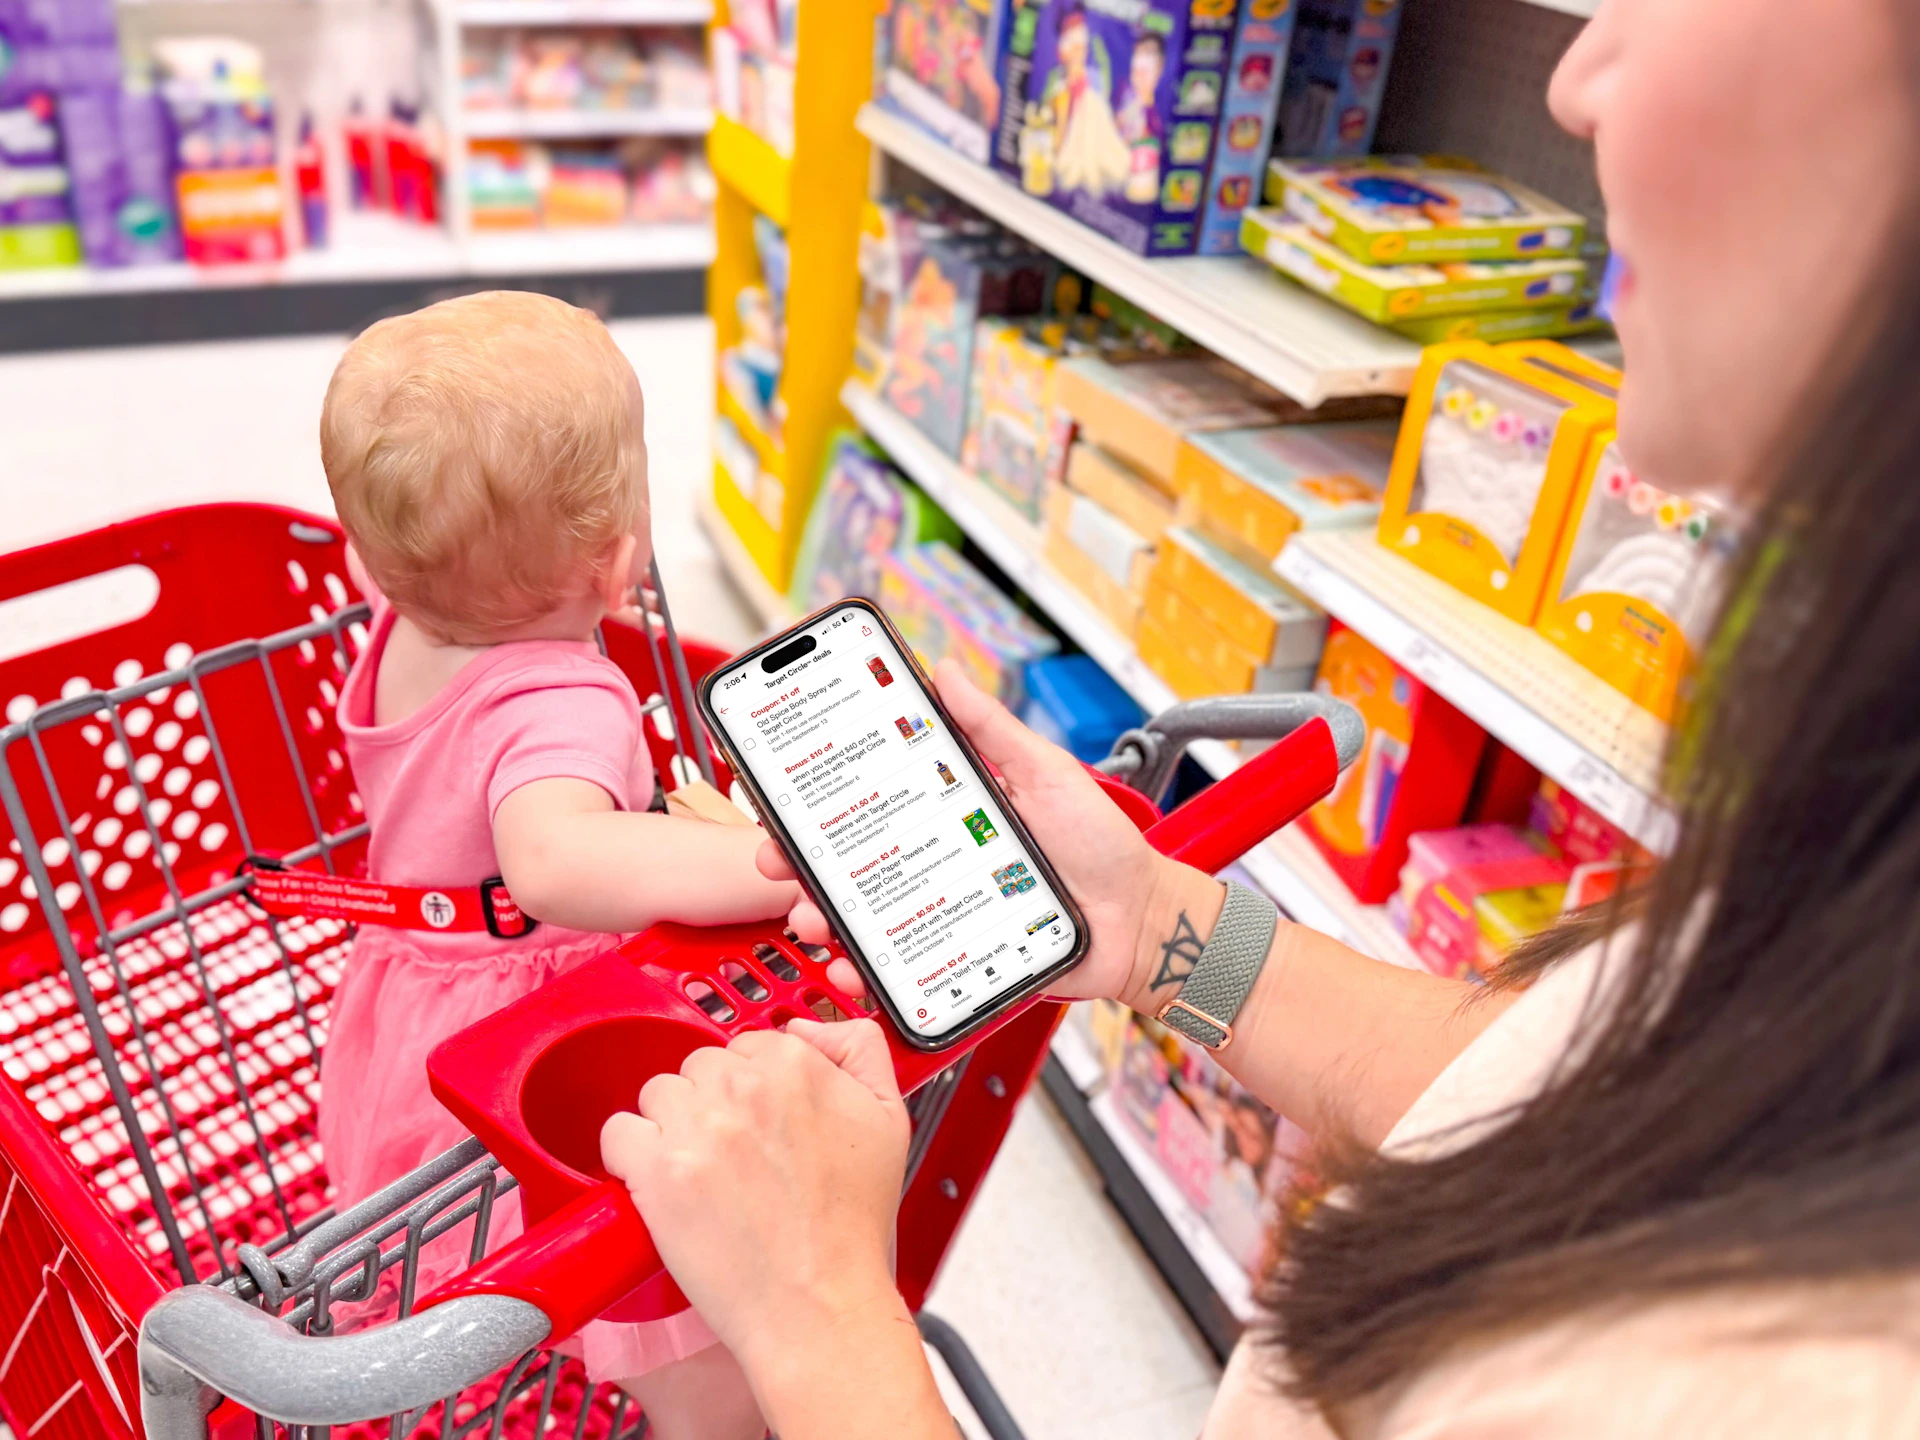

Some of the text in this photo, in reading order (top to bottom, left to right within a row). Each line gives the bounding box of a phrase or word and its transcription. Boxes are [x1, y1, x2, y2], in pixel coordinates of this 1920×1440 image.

[724, 677, 741, 690] 2:06
[832, 621, 842, 629] 5G
[764, 674, 788, 689] Target
[813, 650, 832, 663] deals
[751, 687, 800, 719] Coupon: $1 off
[757, 678, 842, 728] Old Spice Body Spray with
[767, 690, 862, 745] Limit 1-time use manufacturer coupon
[761, 711, 803, 736] Target Circle
[772, 740, 792, 753] Expires
[792, 723, 820, 742] September
[912, 736, 923, 744] days
[785, 742, 834, 774] Bonus: $10 off
[792, 730, 880, 784] when you spend $40 on Pet
[797, 738, 886, 793] care items with Target Circle
[802, 775, 843, 801] Limit 1-time use
[807, 796, 827, 809] Expires
[827, 779, 855, 798] September
[945, 787, 956, 795] days
[820, 792, 880, 830] Coupon: $1.50 off
[826, 789, 910, 840] Vaseline with Target Circle
[832, 792, 927, 850] Limit 1-time use manufacturer coupon
[837, 844, 857, 858] Expires
[857, 826, 885, 846] September
[850, 845, 900, 879] Coupon: $3 off
[856, 838, 940, 890] Bounty Paper Towels with
[867, 848, 962, 907] Limit 1-time use manufacturer coupon
[344, 884, 388, 901] Securely
[861, 871, 903, 897] Target Circle
[873, 901, 893, 915] Expires
[892, 883, 921, 903] September
[886, 897, 946, 937] Coupon: $0.50 off
[893, 890, 984, 948] Angel Soft with Target Circle
[898, 896, 994, 956] Limit 1-time use manufacturer coupon
[903, 951, 924, 965] Expires
[923, 937, 945, 953] October
[1058, 932, 1073, 942] Target
[918, 952, 968, 987] Coupon: $3 off
[924, 943, 1009, 998] Charmin Toilet Tissue with
[1024, 956, 1034, 964] Cart
[988, 976, 1002, 985] Wallet
[951, 994, 972, 1009] Essentials
[918, 1016, 937, 1030] Discover
